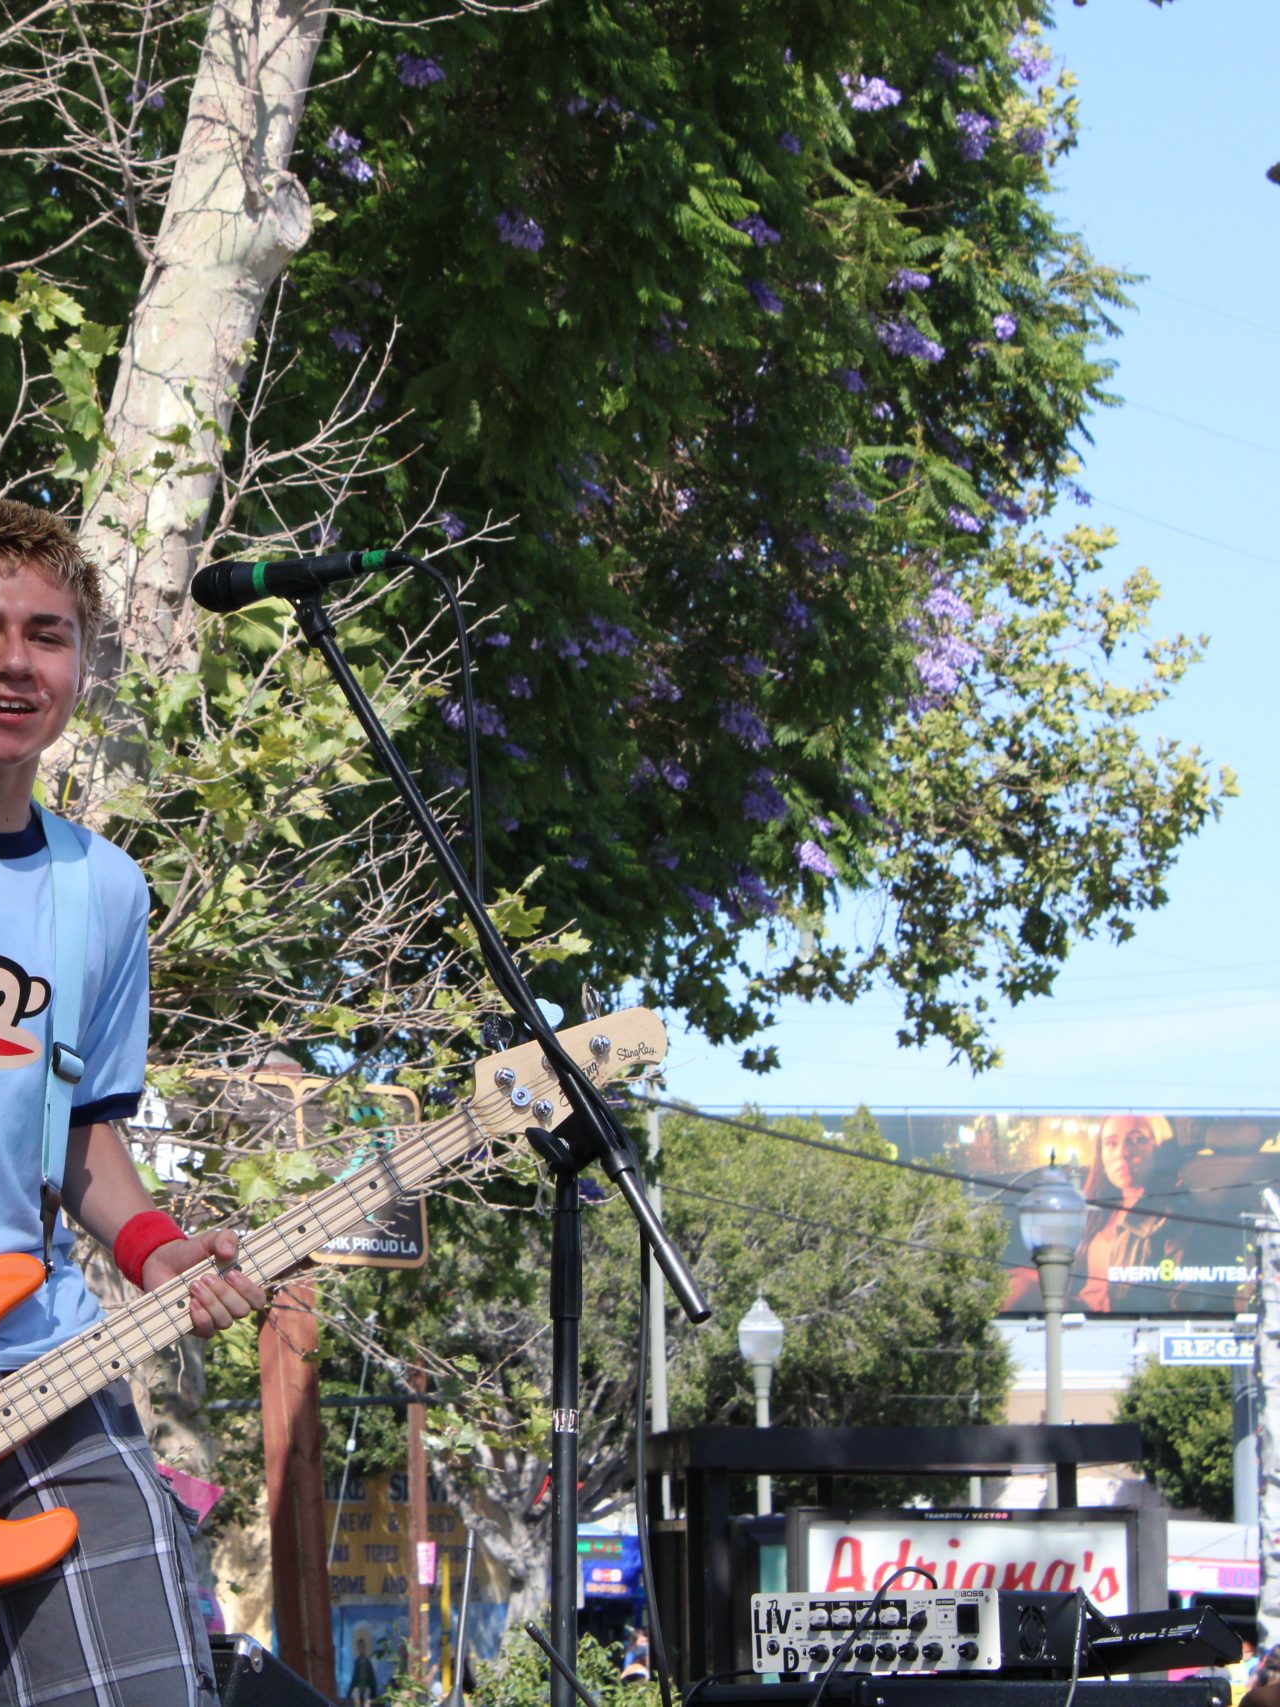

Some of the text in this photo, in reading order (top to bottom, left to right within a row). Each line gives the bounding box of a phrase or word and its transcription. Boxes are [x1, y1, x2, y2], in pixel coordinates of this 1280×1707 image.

[352, 1237, 399, 1252] PROUD
[401, 1241, 418, 1254] LA
[338, 1513, 370, 1531] NEW
[428, 1514, 455, 1532] SED
[364, 1544, 399, 1563] TIRES
[825, 1536, 1120, 1603] Adriana's
[382, 1576, 408, 1594] AND
